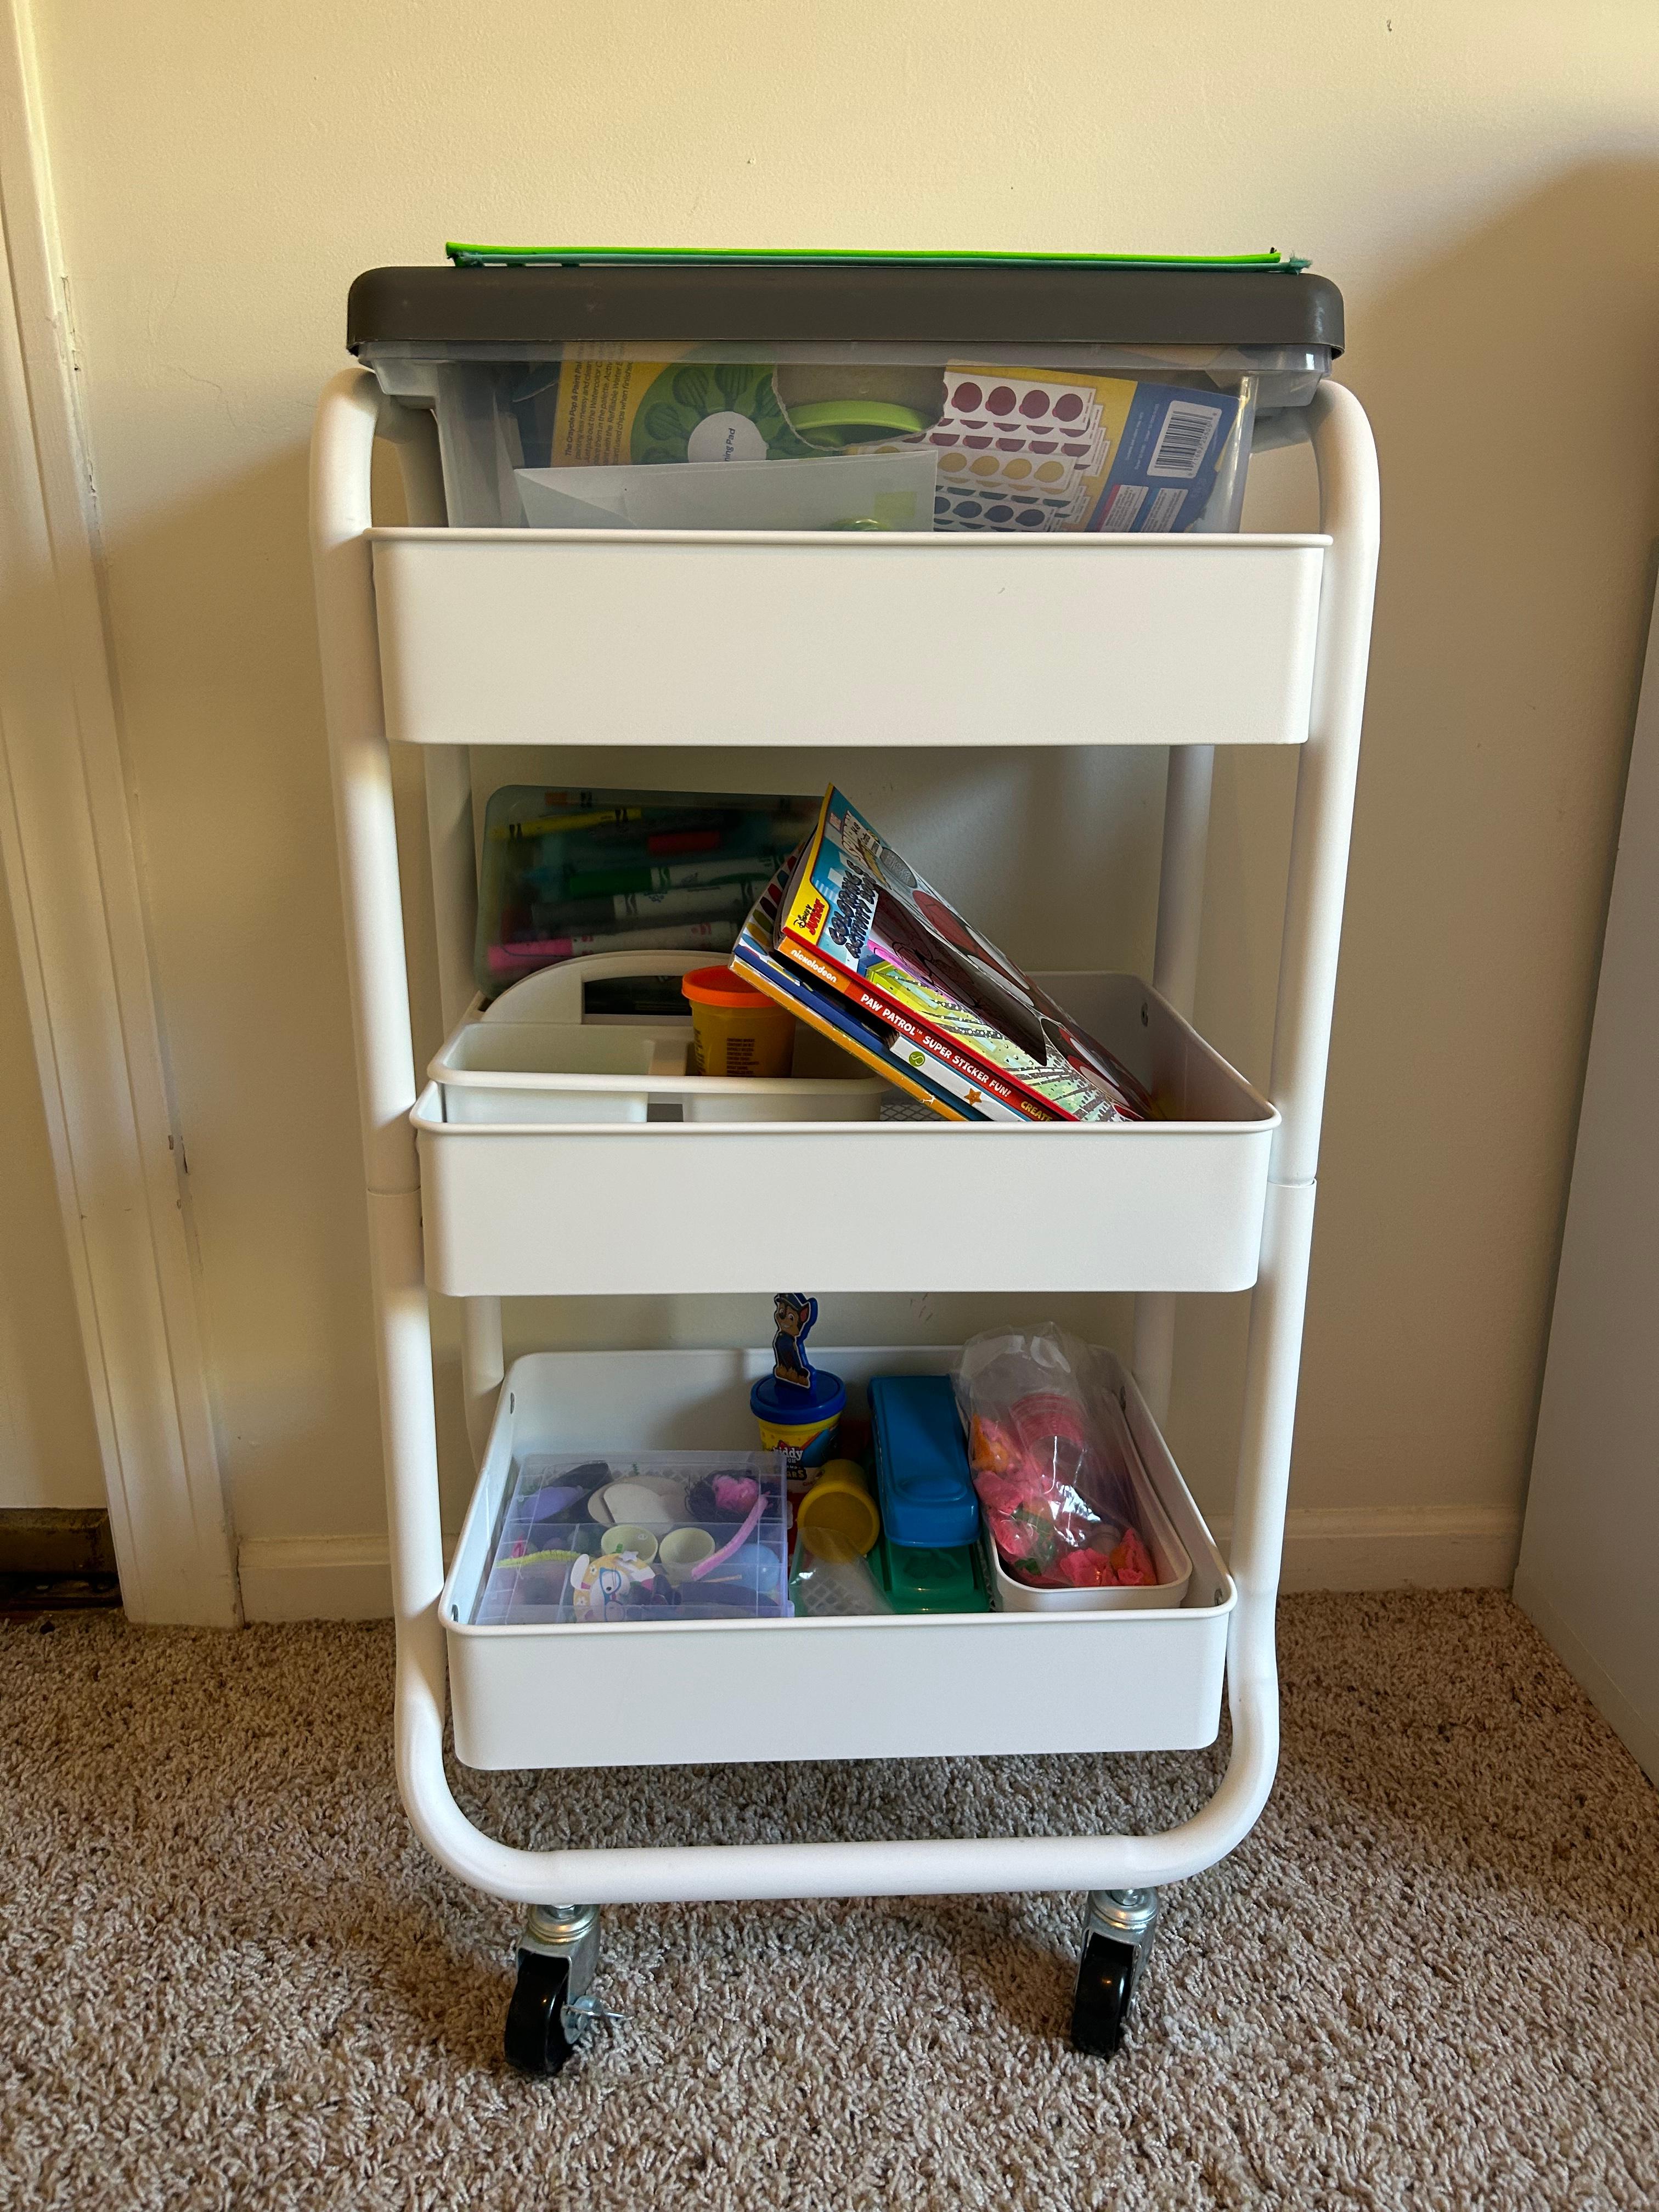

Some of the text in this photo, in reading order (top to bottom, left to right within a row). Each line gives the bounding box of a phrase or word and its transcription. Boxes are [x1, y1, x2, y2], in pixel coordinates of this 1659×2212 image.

[572, 375, 581, 394] Paint
[582, 381, 590, 396] and
[590, 368, 601, 409] Watercolor
[612, 367, 622, 389] Water
[569, 402, 578, 416] Pop
[580, 397, 589, 420] messy
[619, 391, 628, 410] when
[567, 417, 575, 443] Crayola
[616, 410, 625, 430] chips
[726, 428, 736, 445] Pad
[793, 904, 813, 929] Disney
[829, 870, 862, 946] COLORING
[845, 899, 872, 959] ACTIVITY
[859, 872, 877, 905] BOOK
[791, 949, 837, 984] nickelodeon
[860, 993, 883, 1012] PAW
[922, 1035, 952, 1059] SUPER
[952, 1054, 989, 1084] STICKER
[989, 1079, 1012, 1098] FUN!
